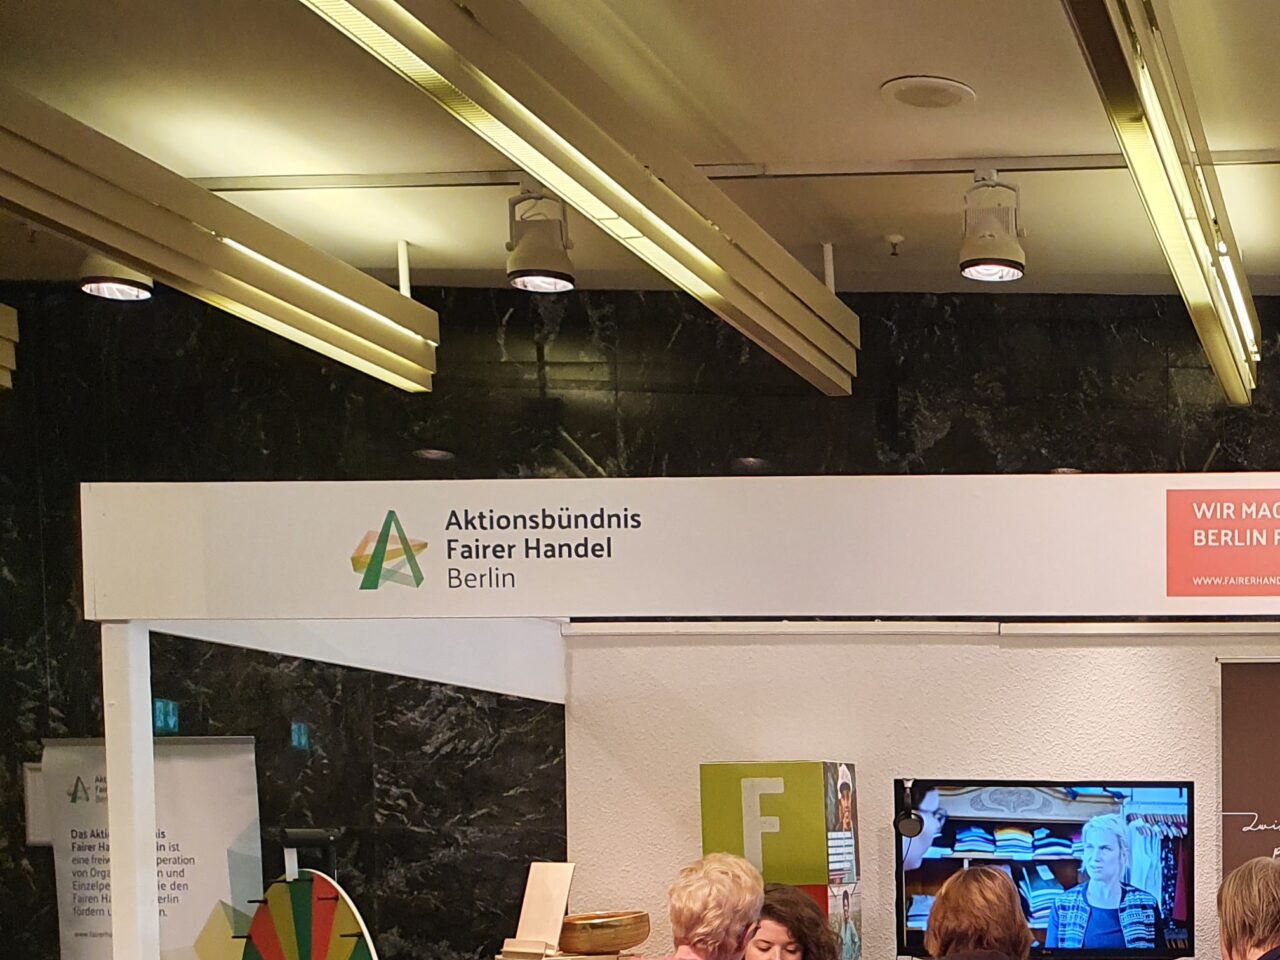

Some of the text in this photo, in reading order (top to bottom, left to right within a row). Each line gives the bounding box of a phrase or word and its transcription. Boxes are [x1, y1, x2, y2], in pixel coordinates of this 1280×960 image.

[1192, 502, 1235, 519] WIR
[445, 507, 642, 531] Aktionsbündnis
[1193, 529, 1267, 546] BERLIN
[446, 537, 612, 560] Fairer Handel
[448, 567, 516, 589] Berlin
[71, 830, 87, 839] Das
[71, 842, 96, 852] Fairer
[168, 843, 180, 852] ist
[72, 856, 89, 865] eine
[156, 855, 195, 867] peration
[72, 869, 88, 878] von
[166, 868, 185, 878] und
[72, 880, 111, 893] Einzelpe
[170, 881, 189, 891] den
[73, 894, 99, 904] Fairen
[157, 894, 179, 904] erlin
[73, 906, 105, 917] fördern
